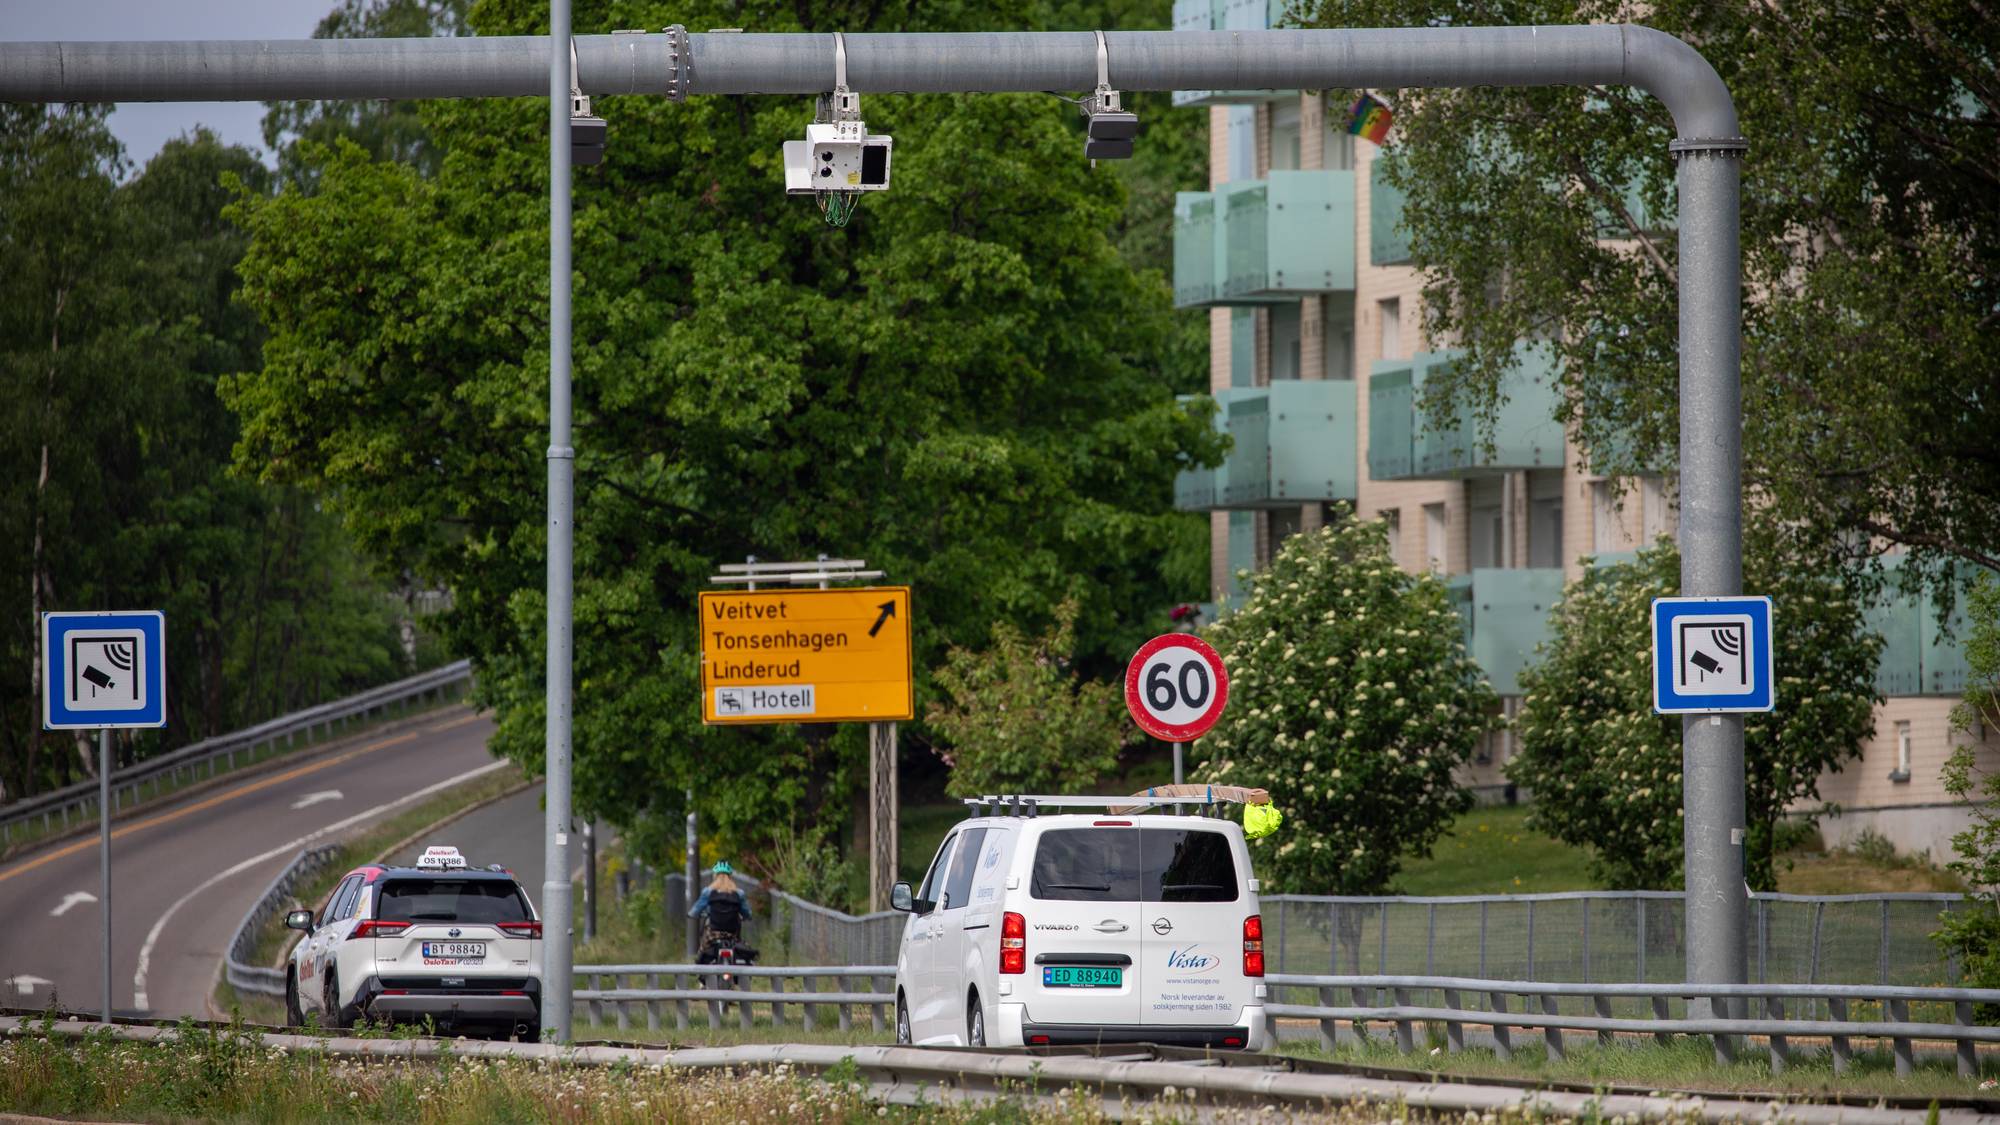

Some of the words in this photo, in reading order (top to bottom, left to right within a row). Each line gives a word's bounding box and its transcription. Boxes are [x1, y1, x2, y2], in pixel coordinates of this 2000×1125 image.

[712, 601, 787, 619] Veitvet
[712, 630, 848, 652] Tonsenhagen
[713, 660, 800, 679] Linderud
[1146, 660, 1210, 711] 60
[752, 689, 810, 708] Hotell
[432, 944, 445, 954] BT
[450, 944, 482, 955] 98842
[1168, 944, 1209, 969] Vista
[1055, 970, 1071, 982] ED
[1077, 970, 1119, 983] 88940
[1161, 993, 1180, 1001] Norsk
[1153, 1003, 1195, 1011] solskjerming
[1195, 1003, 1213, 1011] siden
[1215, 1003, 1232, 1011] 1982
